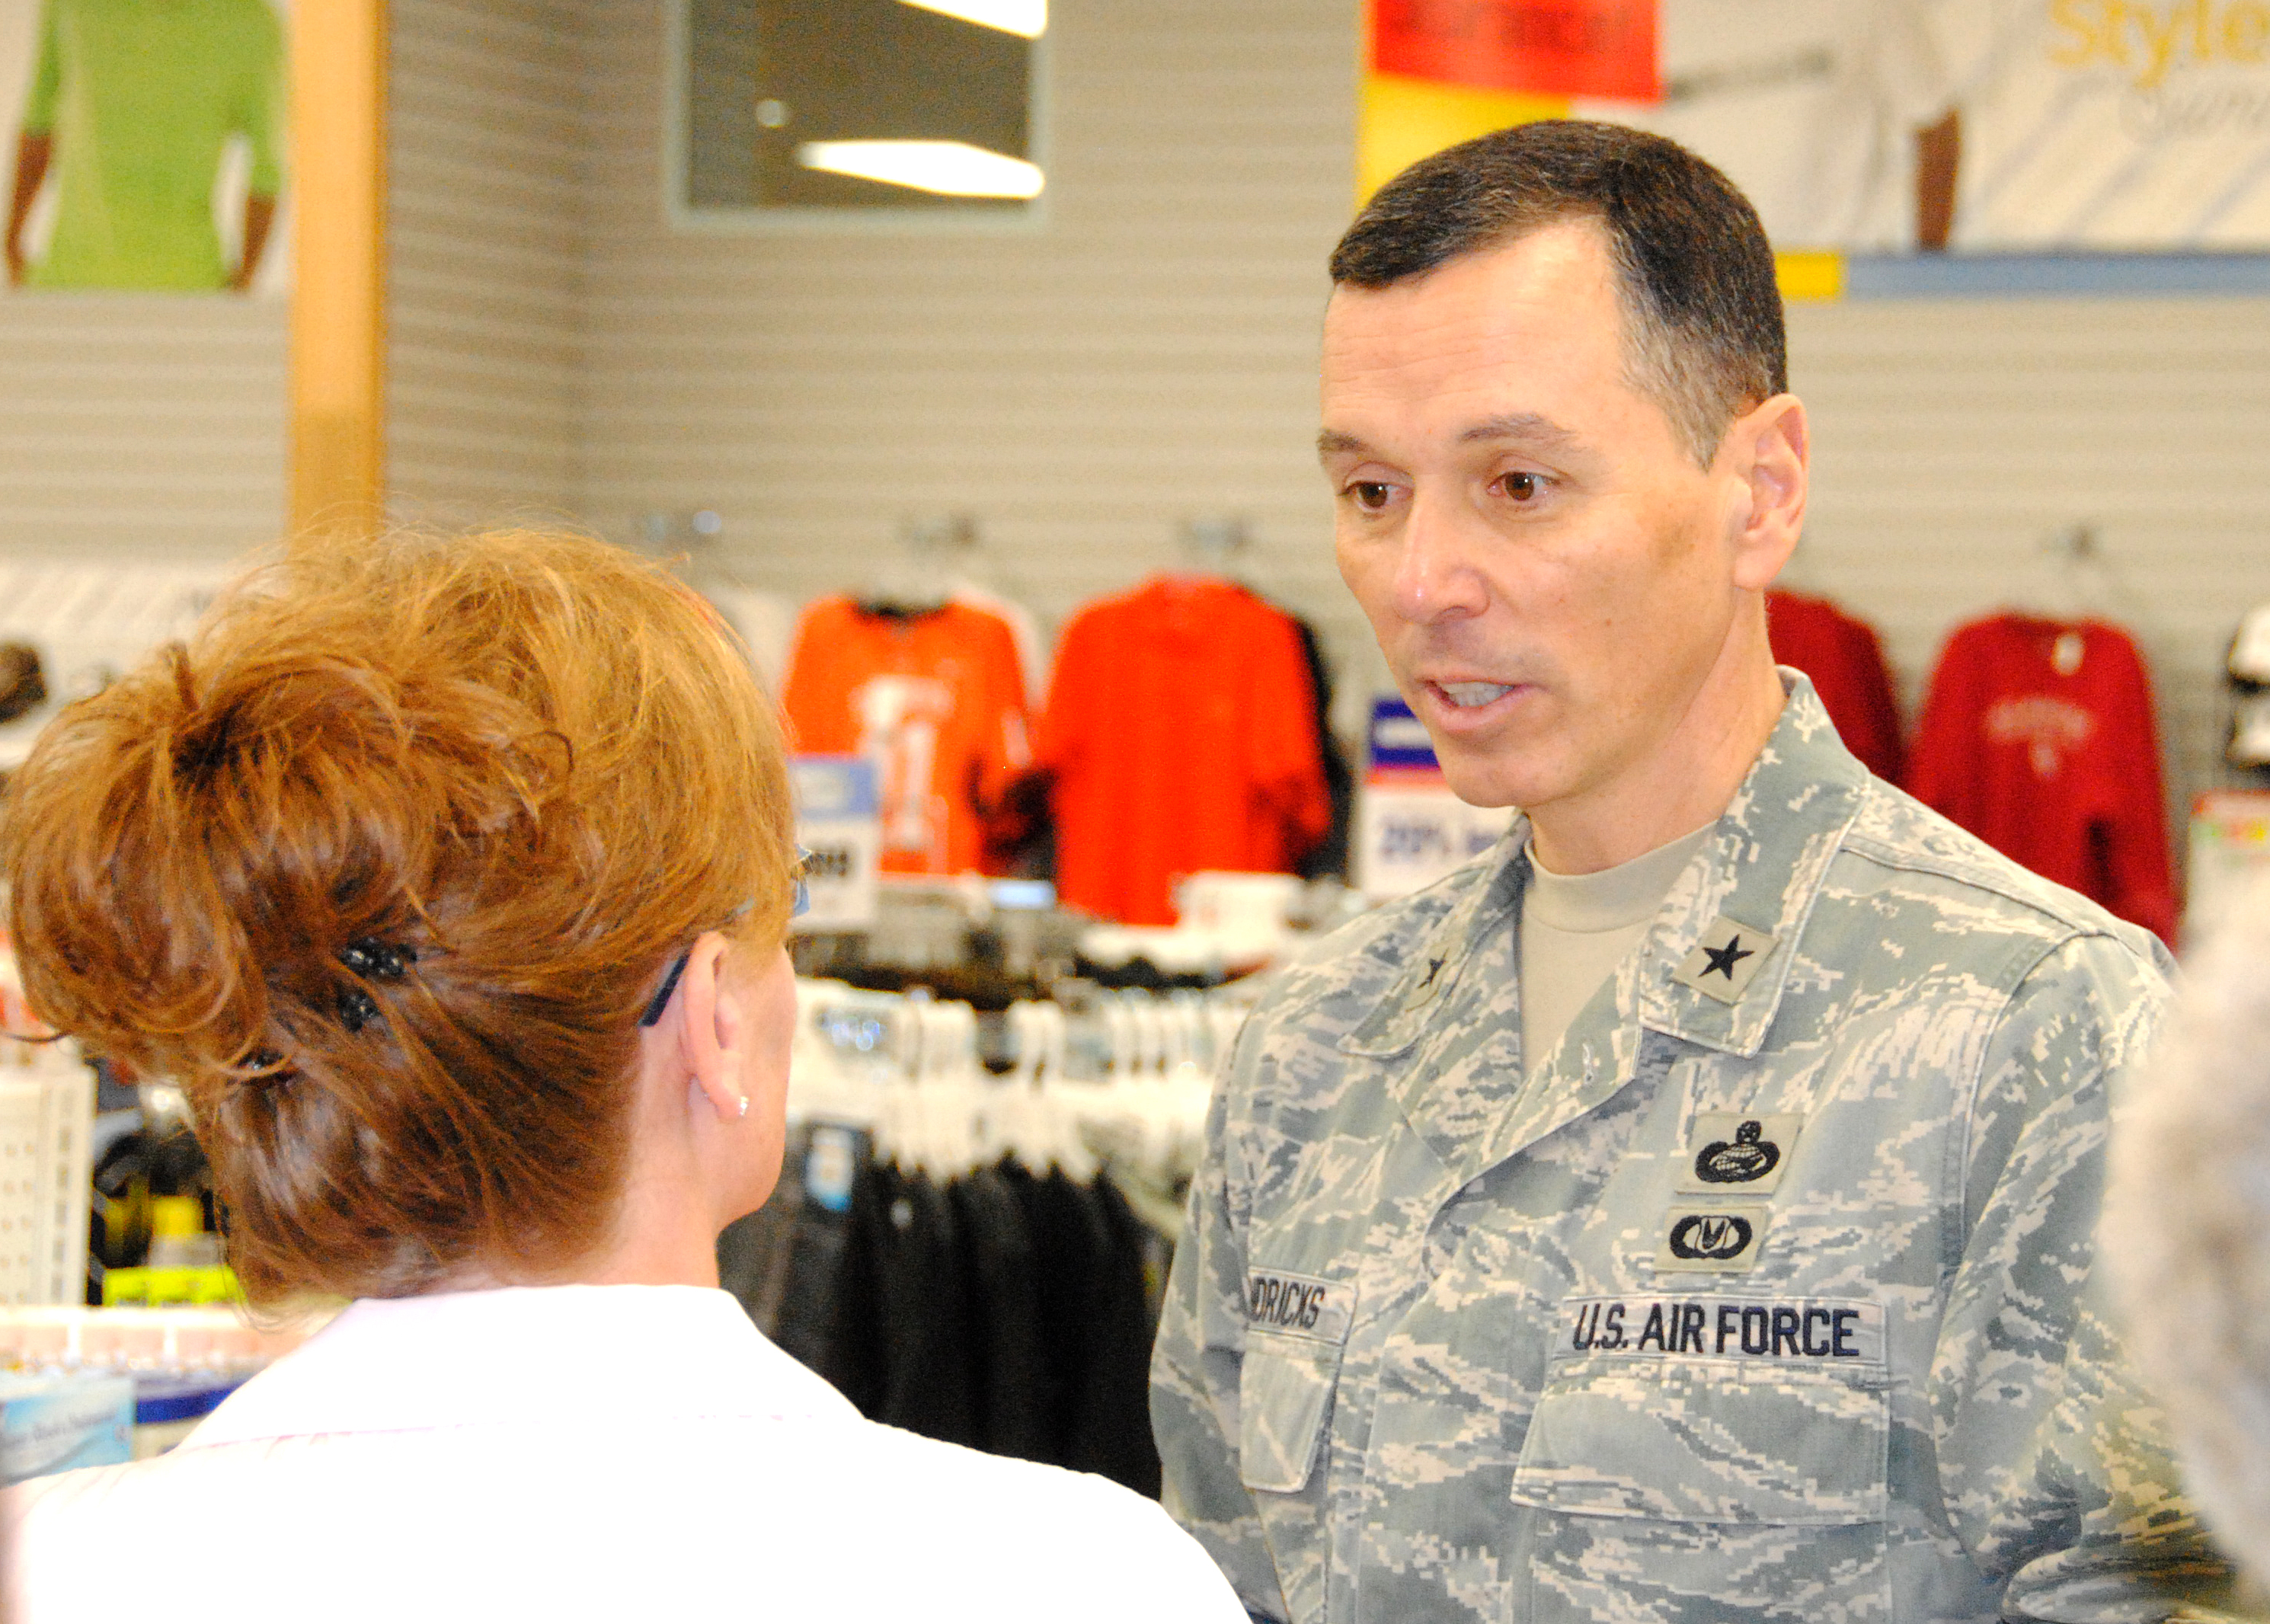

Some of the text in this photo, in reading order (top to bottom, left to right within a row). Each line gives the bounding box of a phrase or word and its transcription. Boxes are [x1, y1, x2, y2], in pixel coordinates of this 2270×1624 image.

[1573, 1303, 1860, 1357] U.S. AIR FORCE
